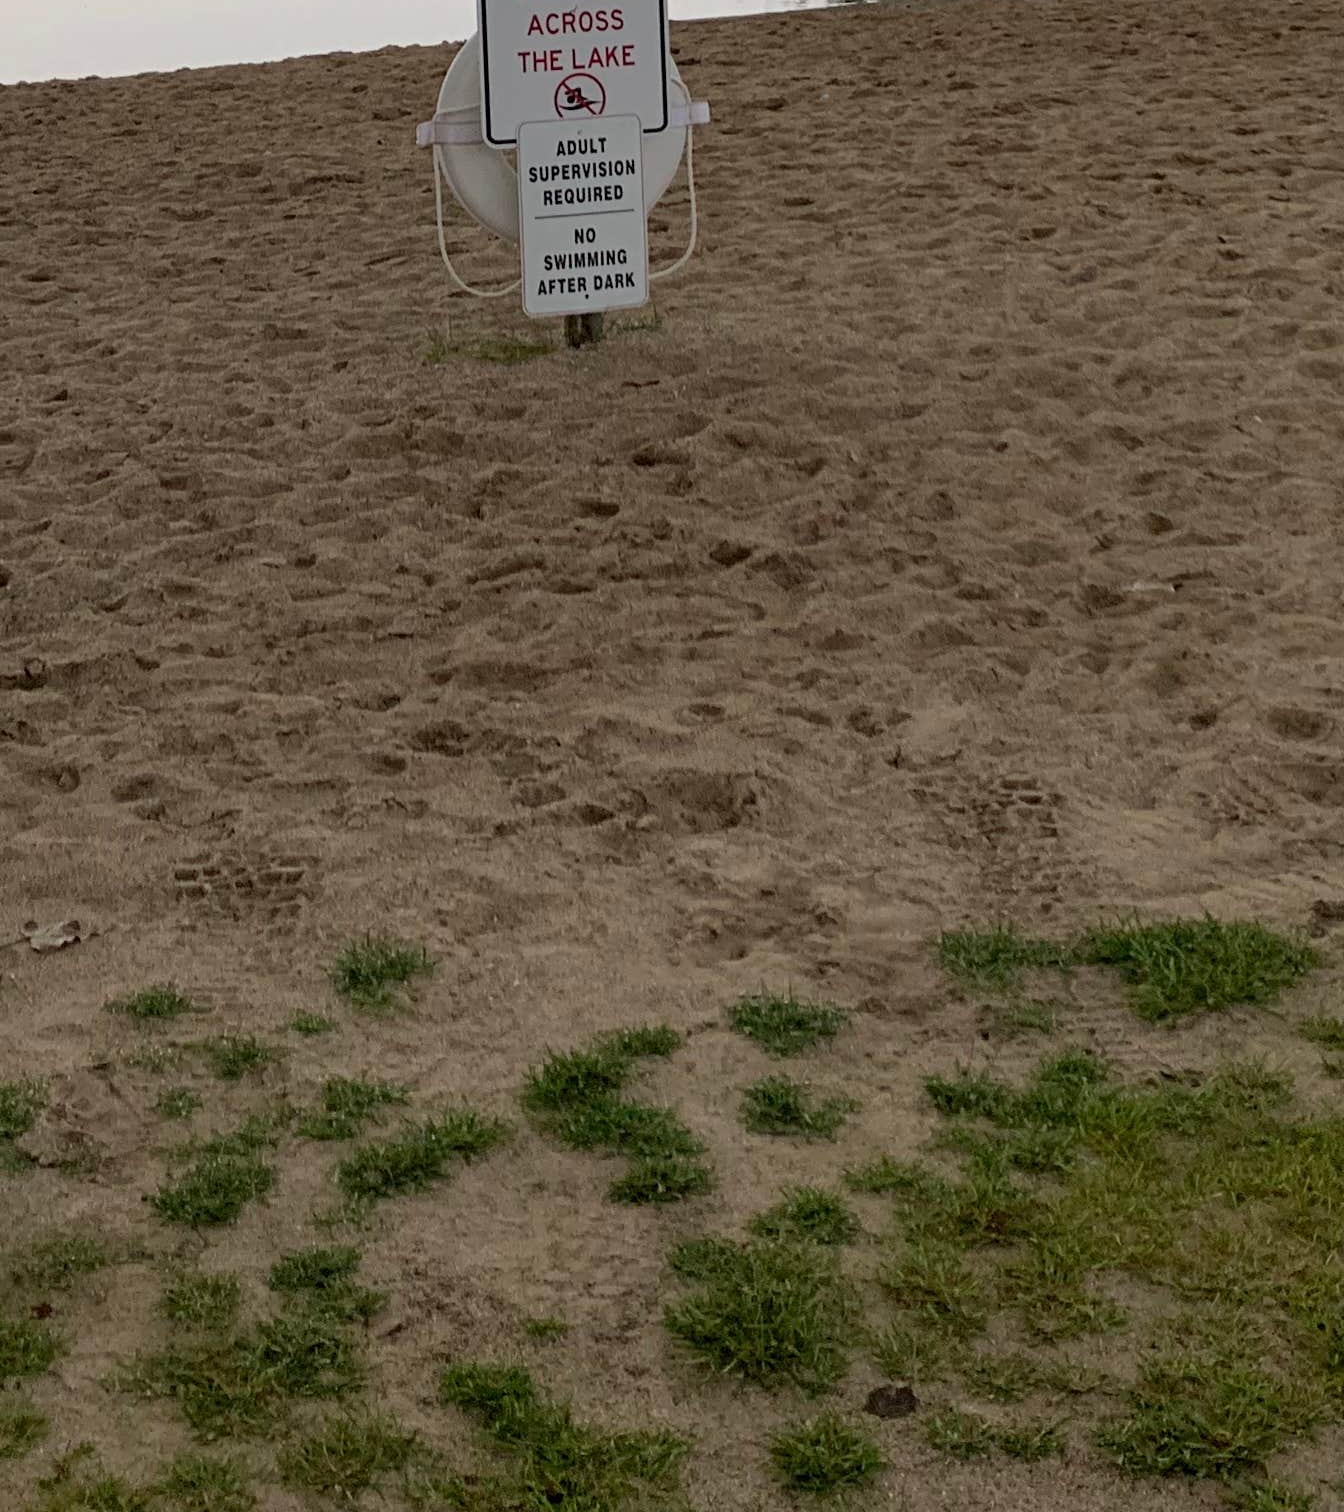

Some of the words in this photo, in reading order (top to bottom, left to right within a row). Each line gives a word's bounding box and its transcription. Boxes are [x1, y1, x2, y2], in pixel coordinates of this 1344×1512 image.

[528, 9, 624, 36] ACROSS
[518, 51, 563, 73] THE
[573, 45, 635, 70] LAKE
[557, 137, 607, 157] ADULT
[529, 159, 635, 182] SUPERVISION
[543, 186, 623, 206] REQUIRED
[575, 228, 596, 244] NO
[544, 250, 627, 271] SWIMMING
[537, 277, 587, 294] AFTER
[594, 273, 635, 291] DARK
